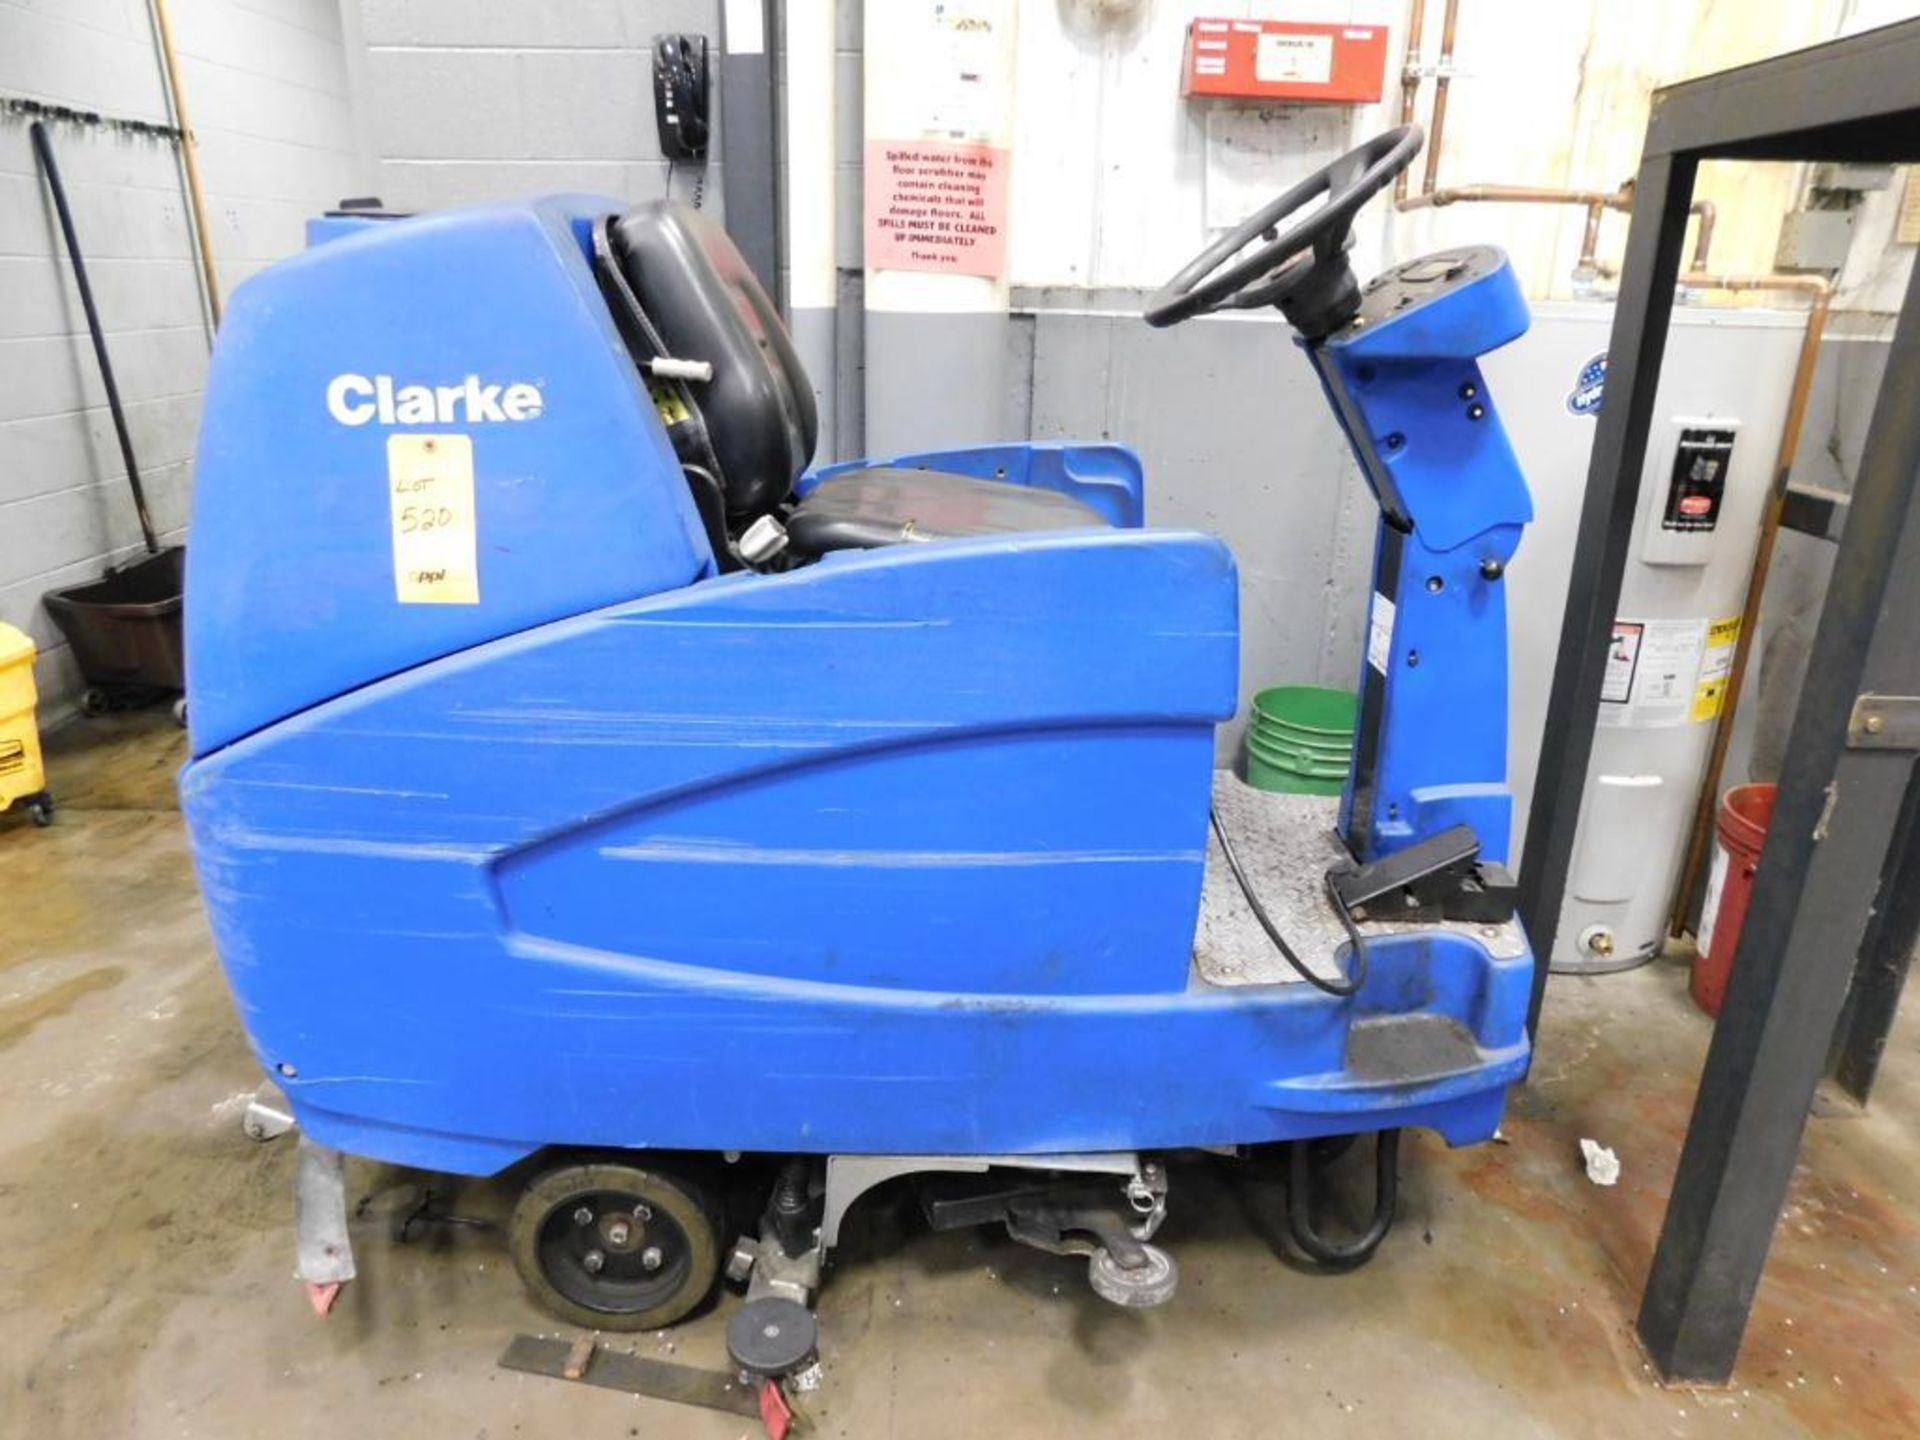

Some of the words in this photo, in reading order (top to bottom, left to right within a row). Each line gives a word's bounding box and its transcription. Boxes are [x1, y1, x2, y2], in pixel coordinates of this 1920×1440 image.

[886, 151, 919, 162] Spilled
[922, 154, 951, 162] water
[954, 155, 977, 166] from
[979, 157, 992, 168] the
[893, 165, 915, 174] floor
[918, 166, 964, 178] scrubber
[967, 171, 986, 181] may
[898, 180, 935, 189] contain
[938, 182, 980, 195] cleaning
[893, 193, 941, 203] chemicals
[945, 196, 965, 205] that
[968, 198, 984, 206] will
[889, 205, 927, 217] damage
[969, 211, 985, 221] ALL
[878, 219, 905, 228] SPILLS
[908, 220, 934, 230] MUST
[938, 222, 950, 231] BE
[954, 223, 997, 235] CLEANED
[894, 233, 907, 242] UP
[908, 234, 976, 246] IMMEDIATELY
[911, 251, 937, 261] Thank
[326, 373, 544, 426] Clarke
[395, 477, 435, 493] LOT
[401, 506, 452, 535] 520
